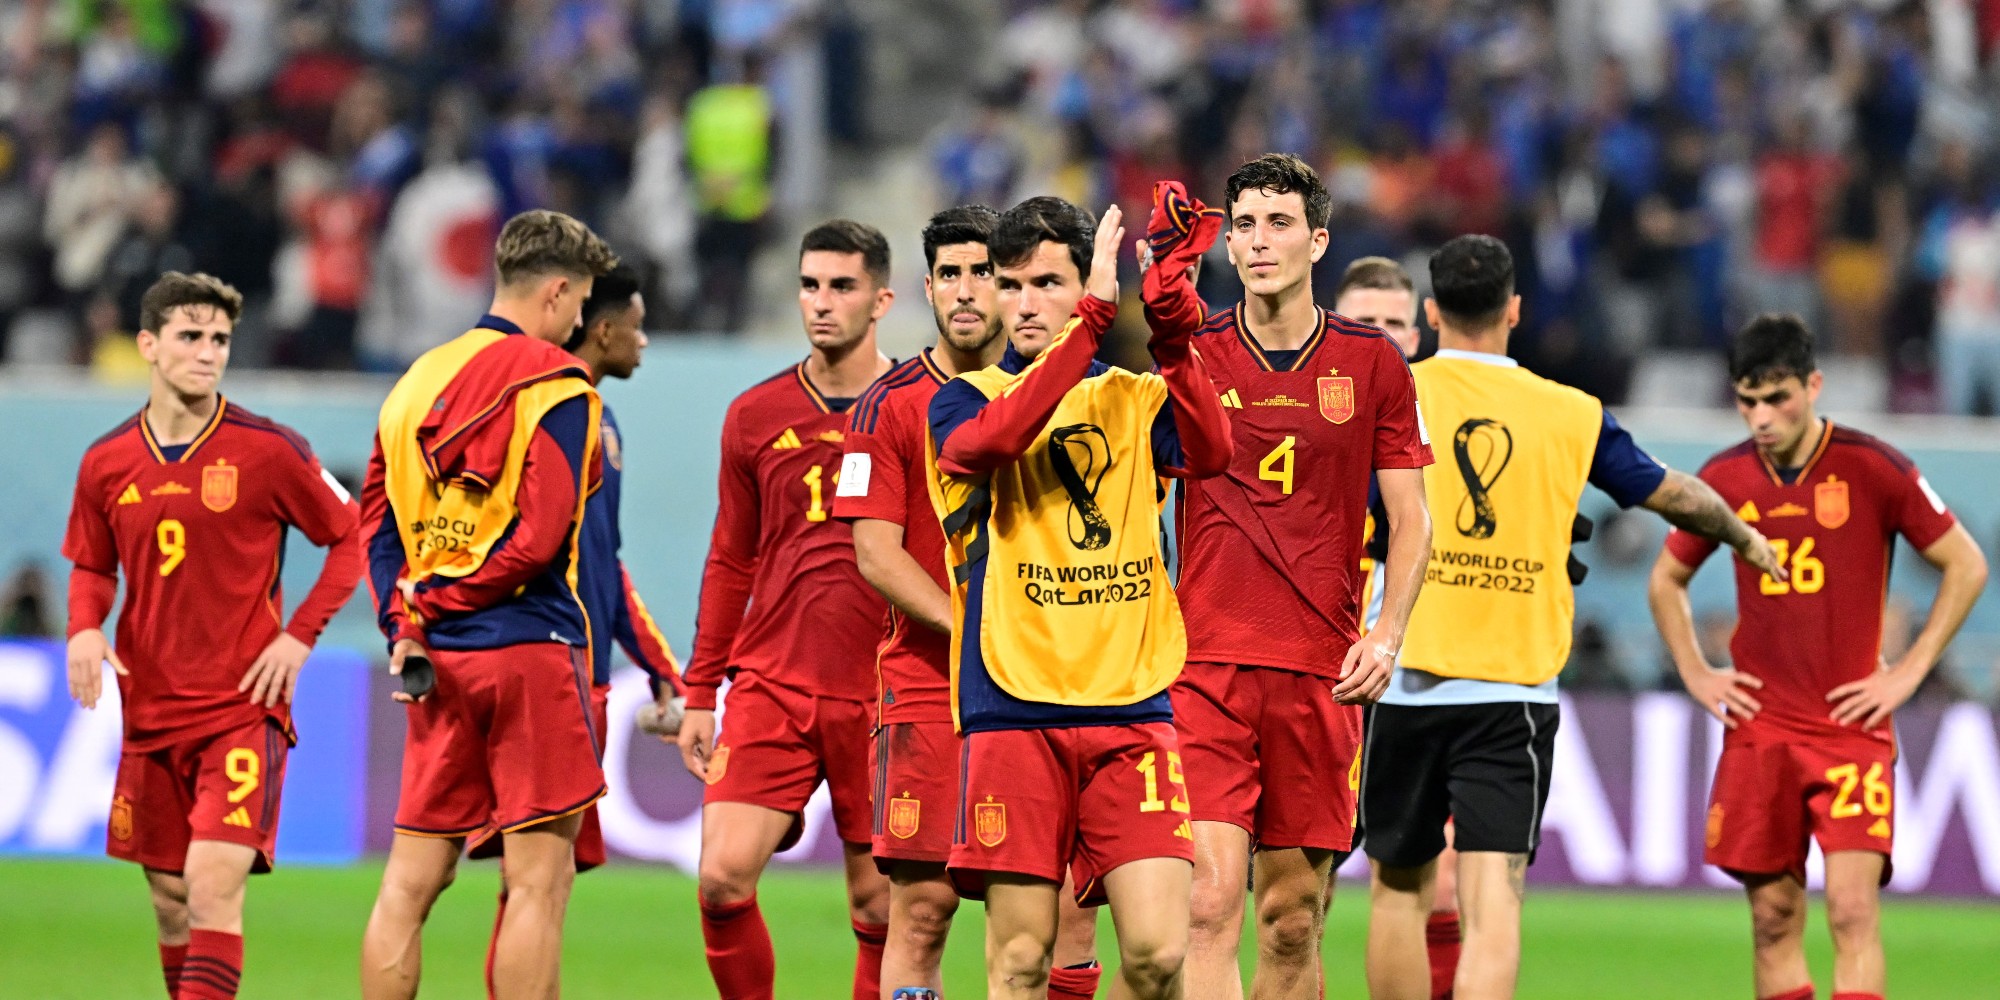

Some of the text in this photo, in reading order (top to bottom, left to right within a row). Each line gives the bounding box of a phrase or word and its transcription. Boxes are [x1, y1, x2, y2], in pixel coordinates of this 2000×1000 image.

[803, 465, 840, 522] 1
[1259, 436, 1295, 495] 4
[157, 519, 186, 577] 9
[452, 519, 476, 537] CU
[1017, 562, 1055, 583] FIFA
[1440, 550, 1508, 570] WORLD
[1512, 558, 1544, 574] CUP
[1760, 536, 1825, 596] 26
[225, 747, 259, 802] 9
[1825, 761, 1892, 819] 26
